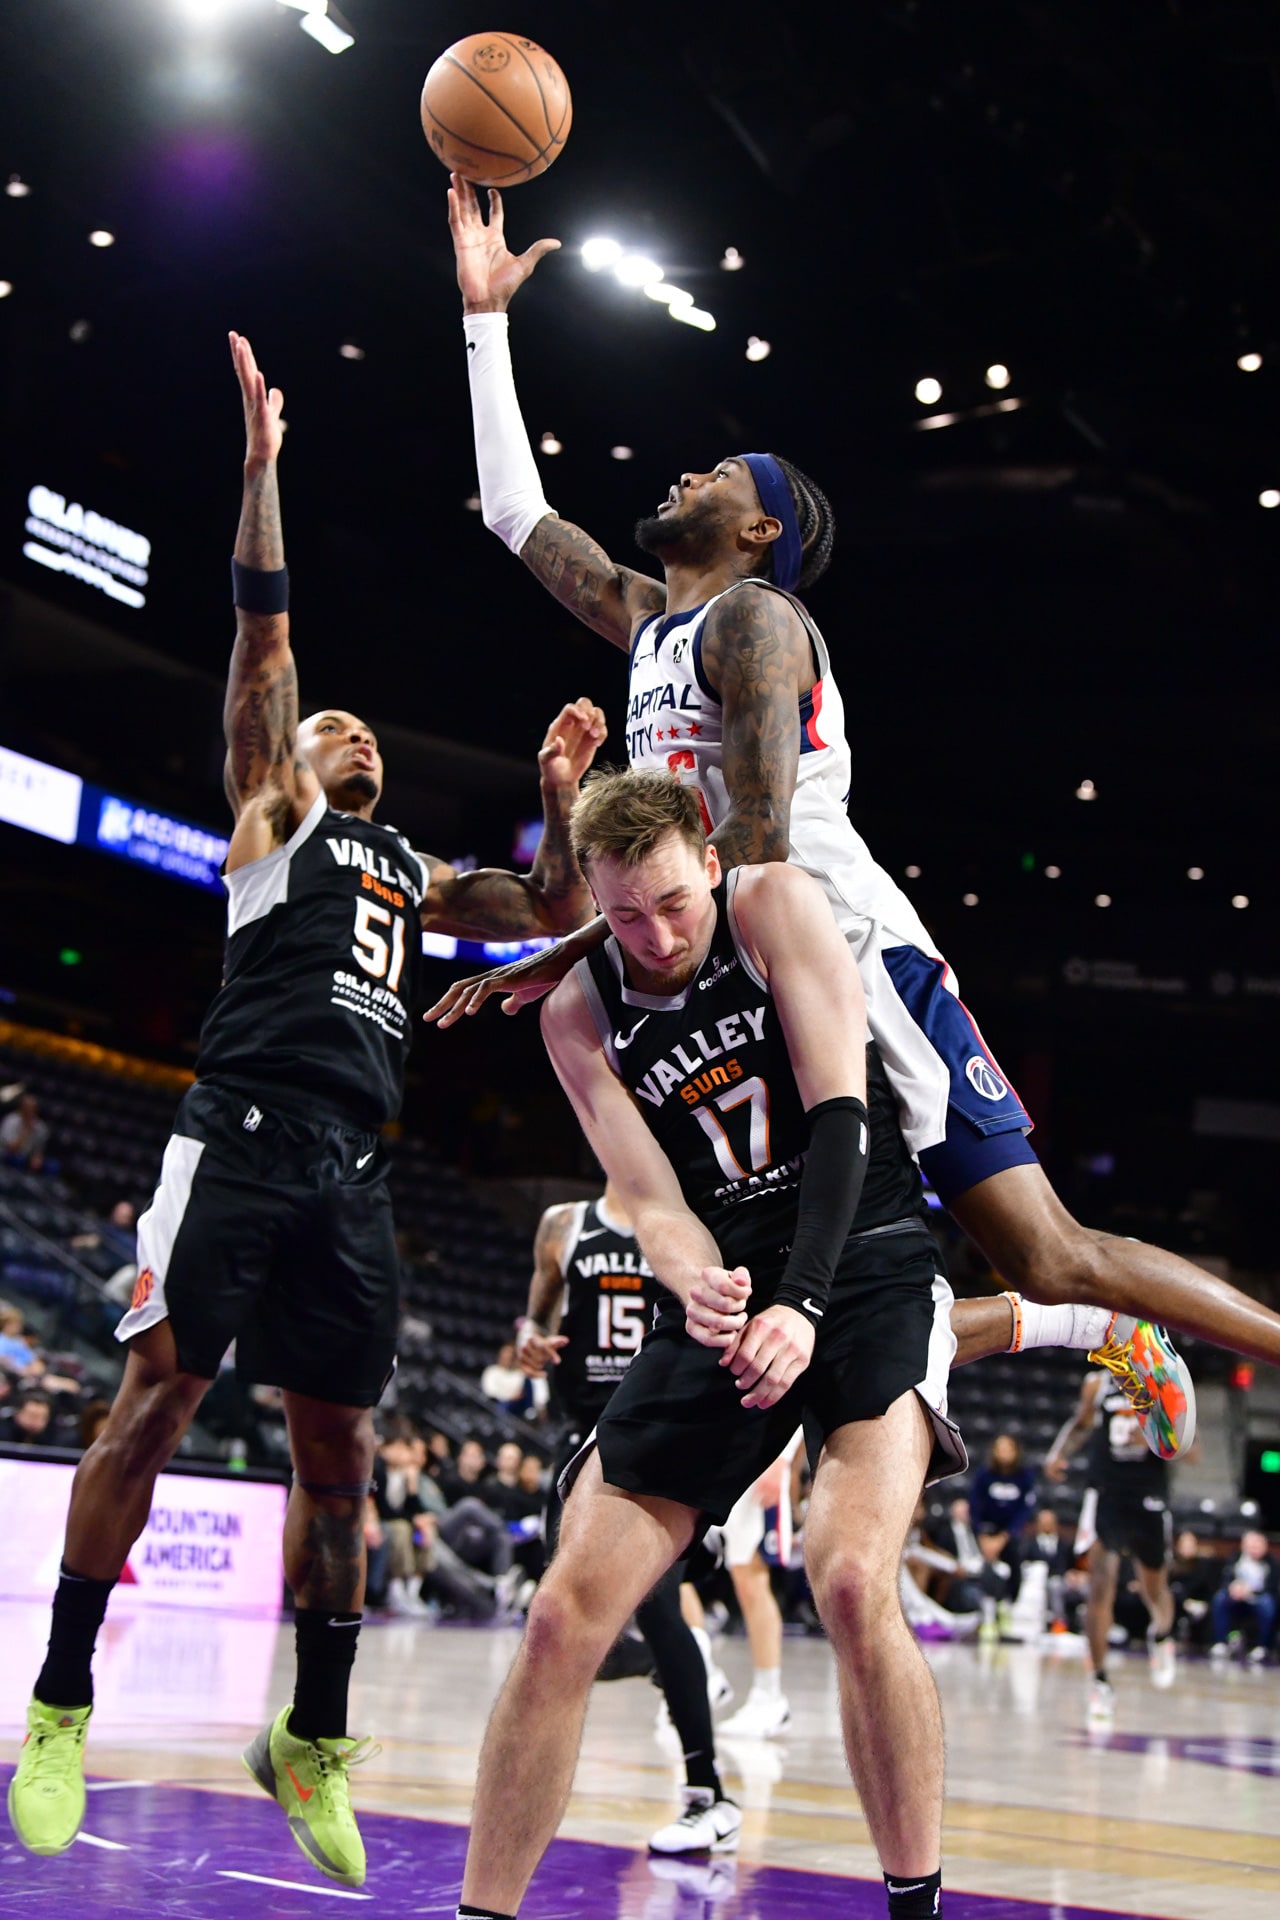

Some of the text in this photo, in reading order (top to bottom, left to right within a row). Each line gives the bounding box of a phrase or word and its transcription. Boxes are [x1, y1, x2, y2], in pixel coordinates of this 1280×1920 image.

[352, 895, 405, 992] 51
[333, 970, 371, 997] GILA
[635, 1006, 766, 1108] VALLEY
[689, 1076, 771, 1183] 17
[597, 1294, 645, 1349] 15
[144, 1543, 233, 1572] AMERICA
